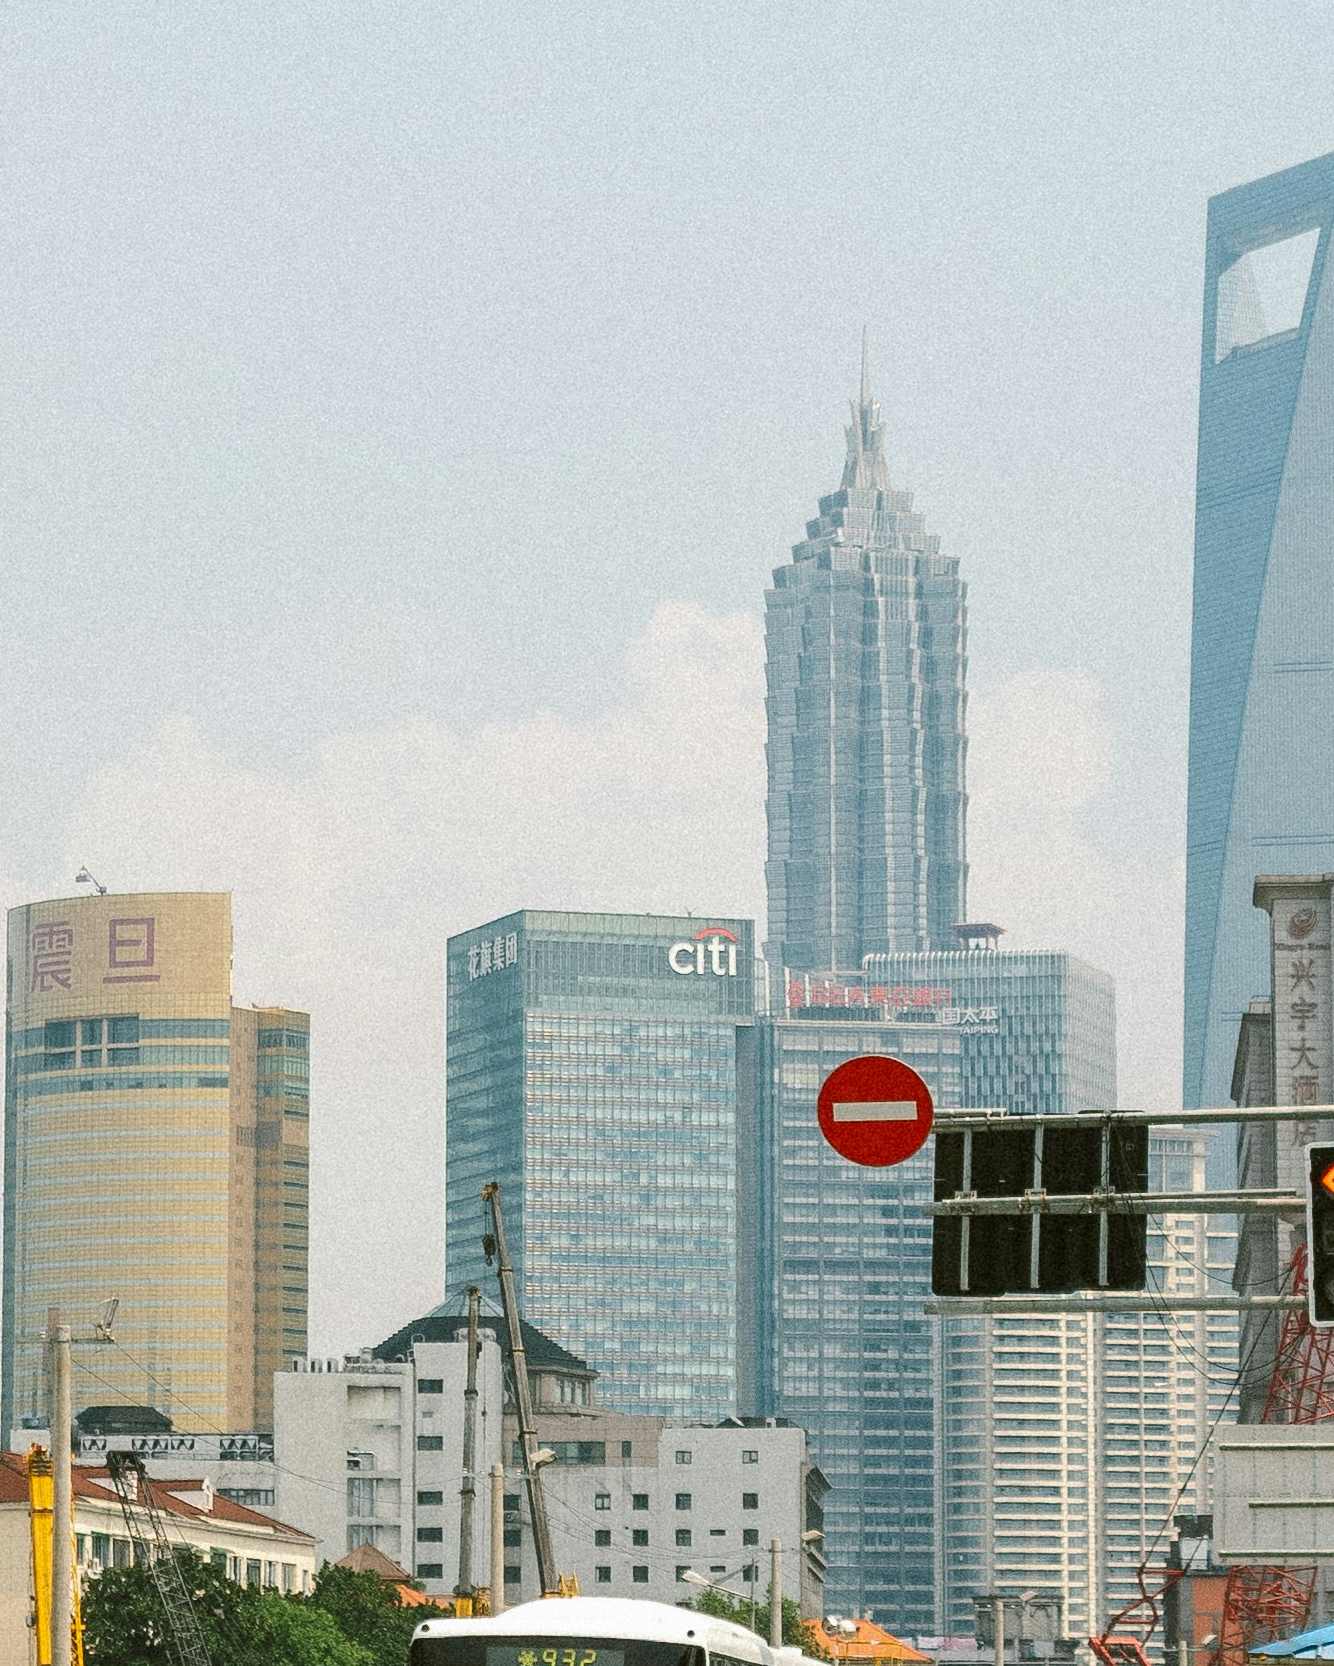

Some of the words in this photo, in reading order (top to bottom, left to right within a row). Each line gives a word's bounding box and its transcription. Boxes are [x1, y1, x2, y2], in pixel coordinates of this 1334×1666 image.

[30, 917, 161, 993] 震旦
[467, 932, 518, 982] 花旗集团
[668, 936, 737, 976] citi
